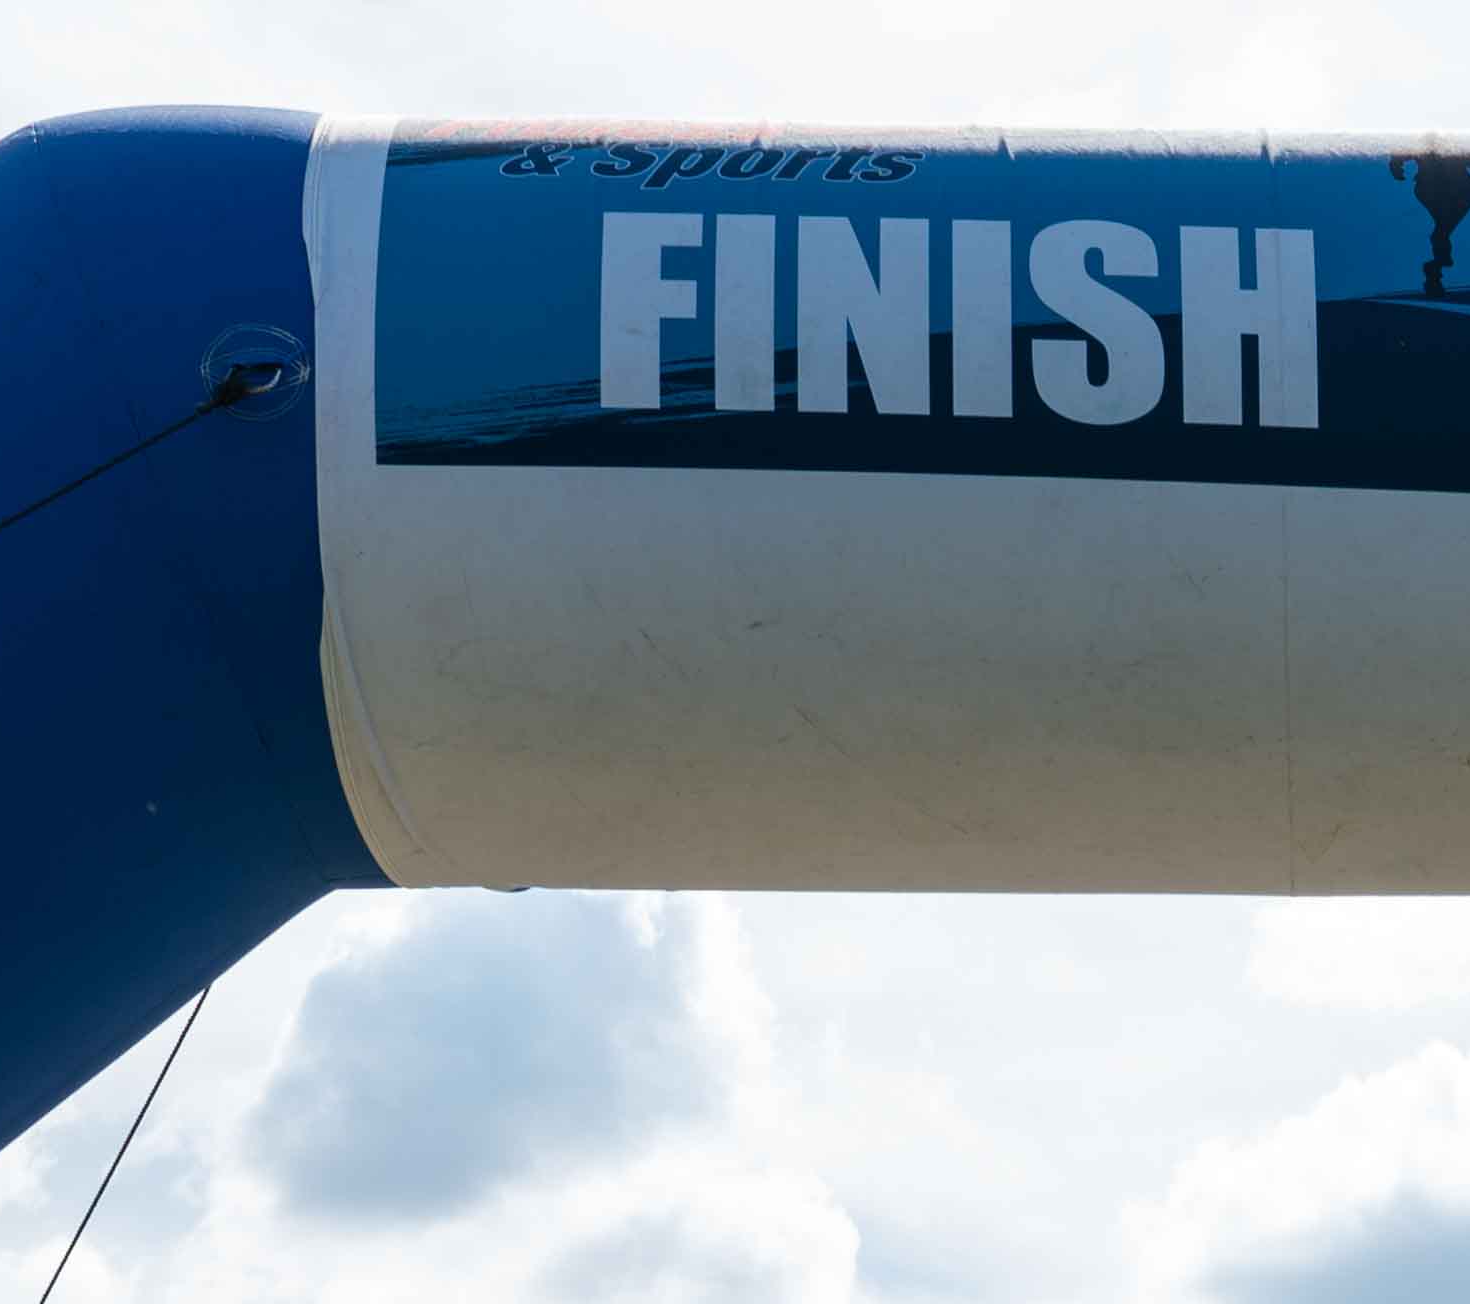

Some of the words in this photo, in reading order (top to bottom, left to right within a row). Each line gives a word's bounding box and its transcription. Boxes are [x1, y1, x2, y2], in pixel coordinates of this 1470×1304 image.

[499, 141, 575, 178] &
[590, 140, 926, 190] Sports
[600, 211, 1320, 428] FINISH
